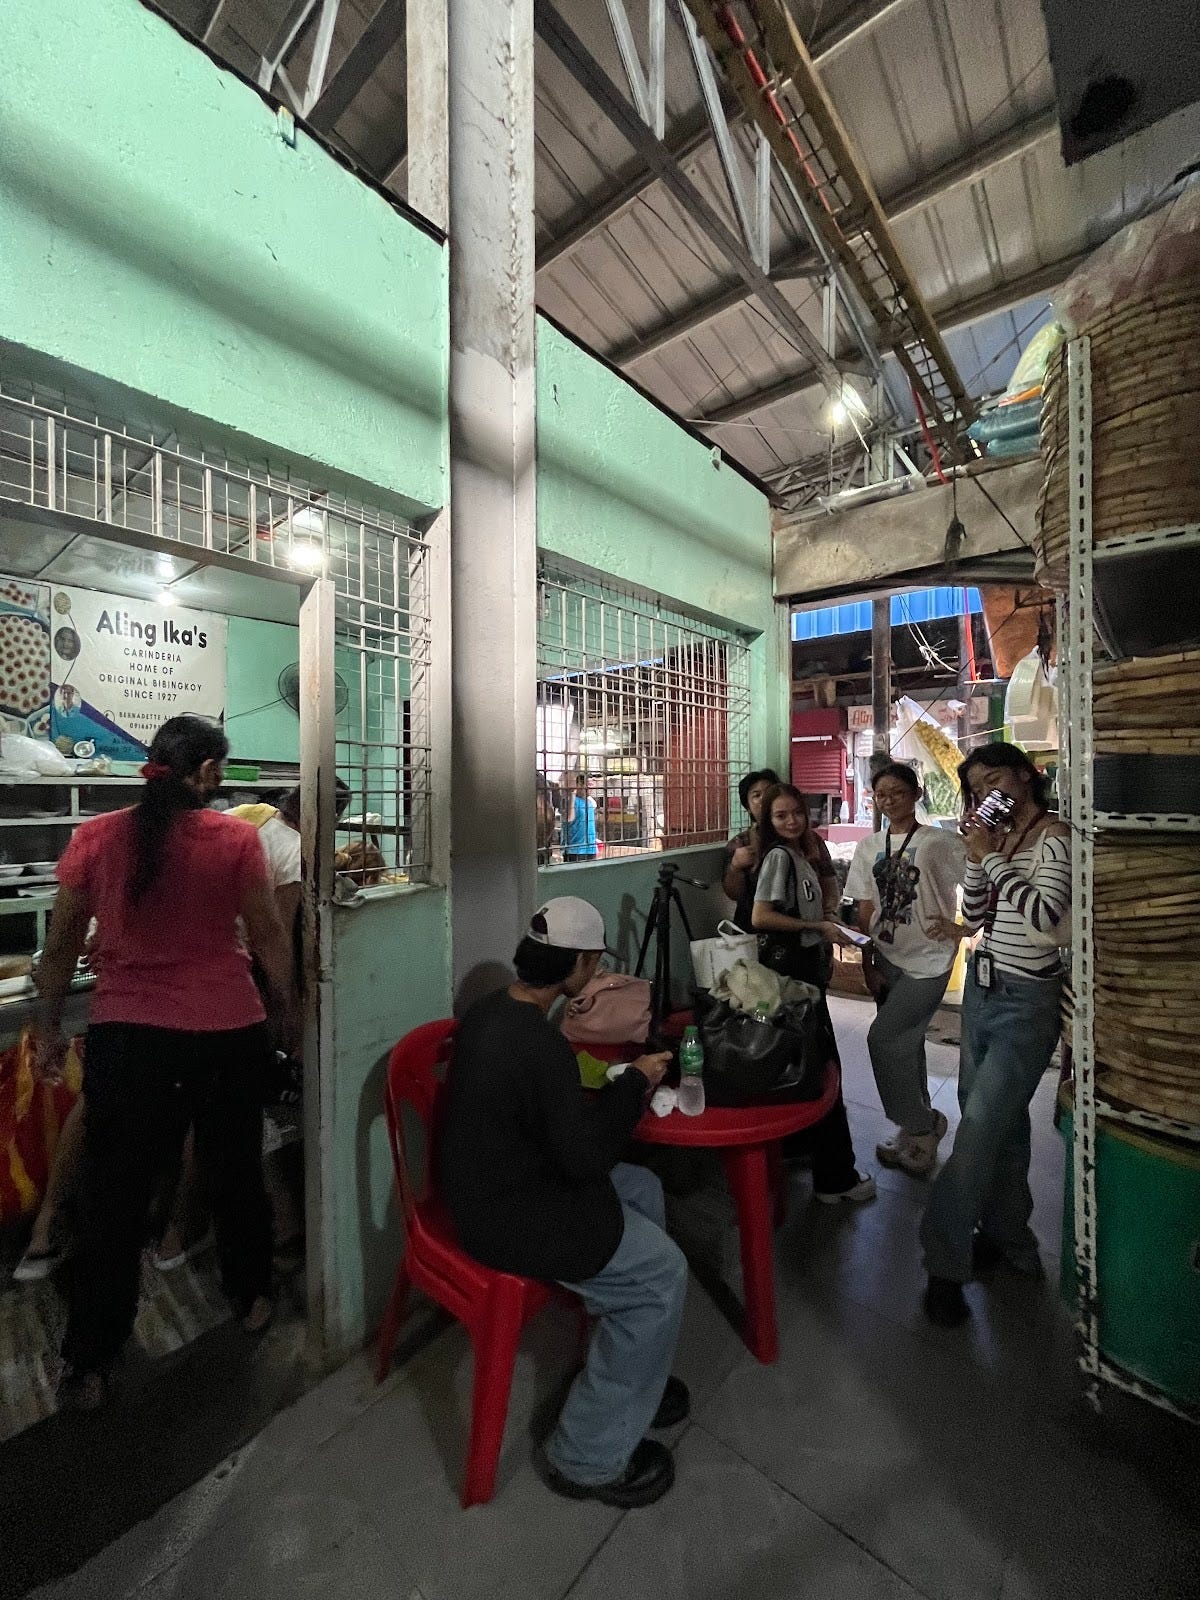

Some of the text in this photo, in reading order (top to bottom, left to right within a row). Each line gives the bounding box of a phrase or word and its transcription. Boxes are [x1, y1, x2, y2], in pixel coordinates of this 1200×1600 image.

[96, 610, 208, 649] Aling Ika's
[123, 647, 182, 663] CARINDERIA
[129, 662, 174, 675] HOME OF
[99, 673, 202, 692] ORIGINAL BIBINGKOY
[124, 689, 177, 702] SINCE 1927
[119, 711, 161, 721] BERNADETTE
[802, 879, 814, 902] C
